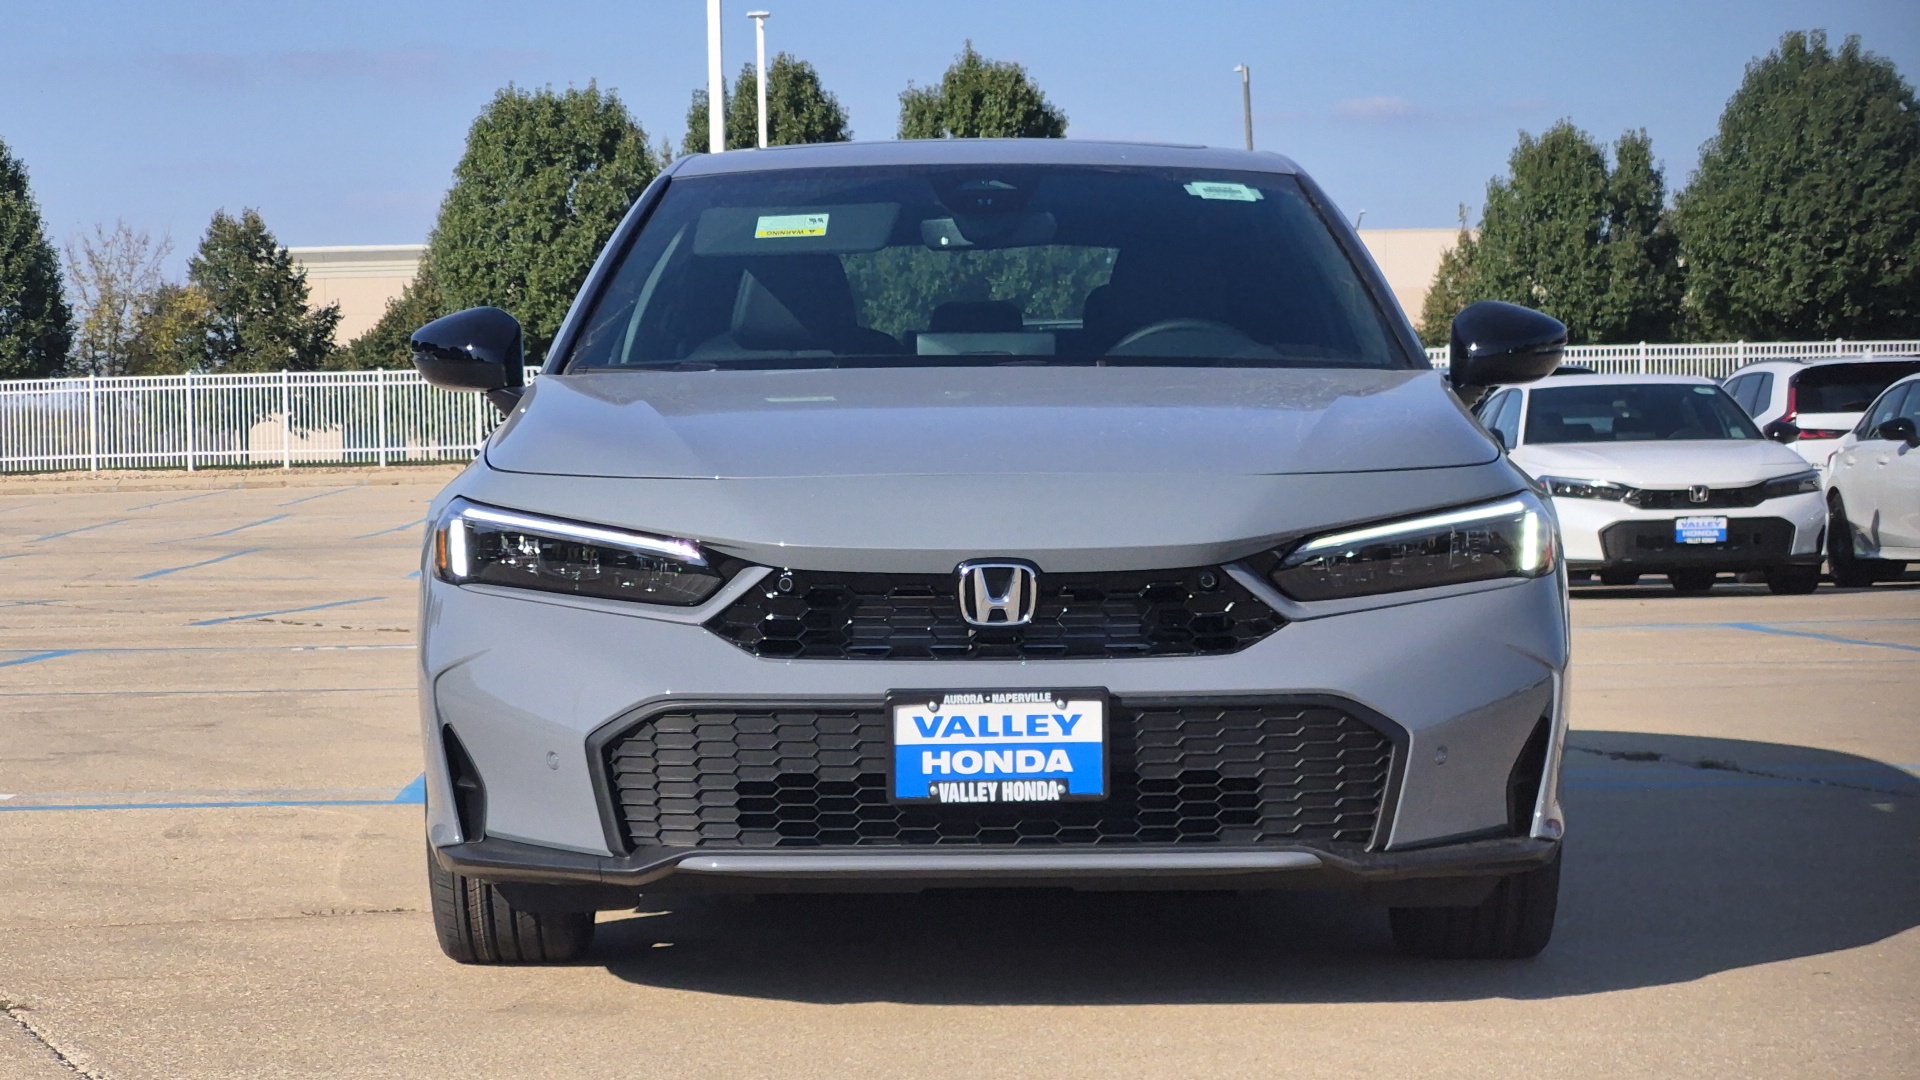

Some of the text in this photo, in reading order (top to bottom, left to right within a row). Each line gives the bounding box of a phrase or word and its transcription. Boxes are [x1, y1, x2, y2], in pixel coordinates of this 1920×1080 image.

[943, 692, 1052, 704] AURORA NAPERVILLE
[912, 714, 1083, 738] VALLEY
[922, 749, 1074, 774] HONDA
[938, 781, 1060, 803] VALLEY HONDA
